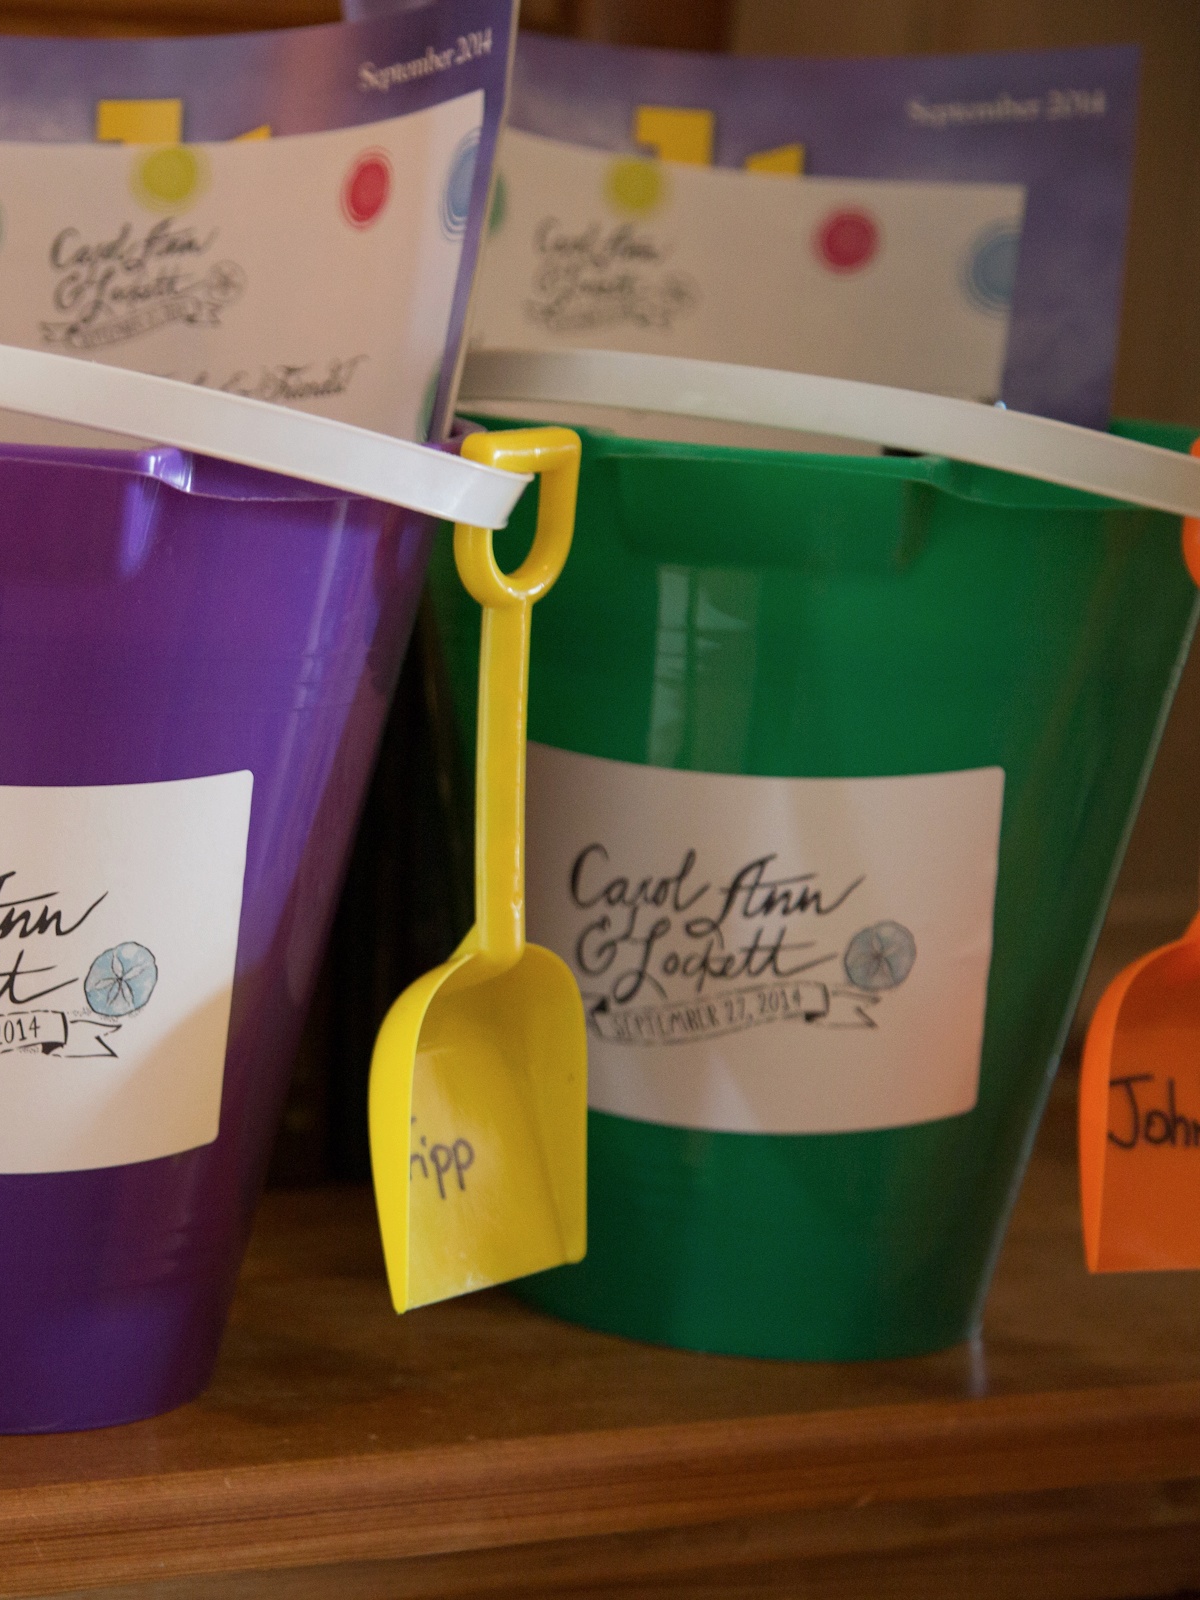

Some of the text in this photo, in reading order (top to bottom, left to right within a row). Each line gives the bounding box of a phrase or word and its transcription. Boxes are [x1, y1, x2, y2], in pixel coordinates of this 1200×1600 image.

[571, 843, 865, 949] Carol Ann
[410, 1116, 475, 1200] ripp
